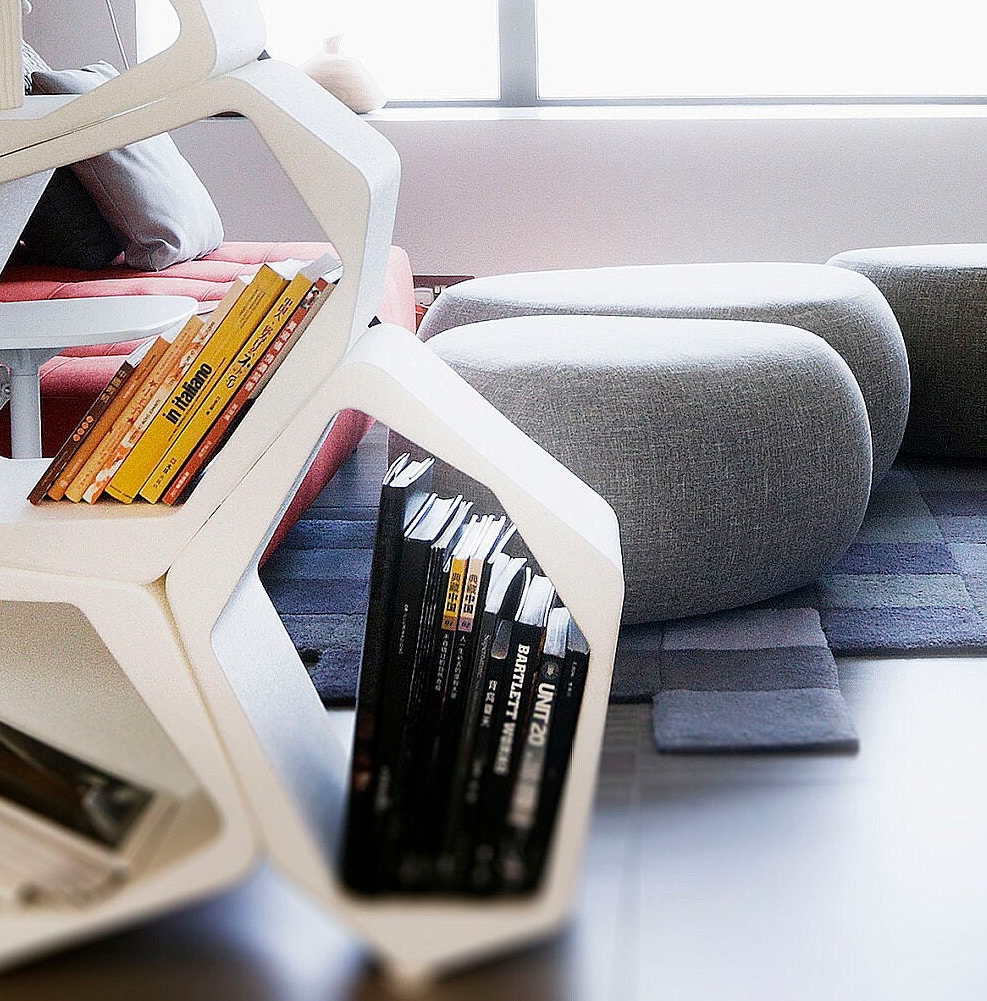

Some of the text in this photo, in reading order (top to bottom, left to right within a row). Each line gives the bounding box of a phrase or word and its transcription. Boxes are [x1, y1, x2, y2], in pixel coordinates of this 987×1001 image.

[171, 363, 213, 412] italiano
[162, 408, 182, 425] in
[505, 643, 530, 720] BARTLETT
[533, 682, 556, 725] UNIT
[527, 721, 548, 747] 20
